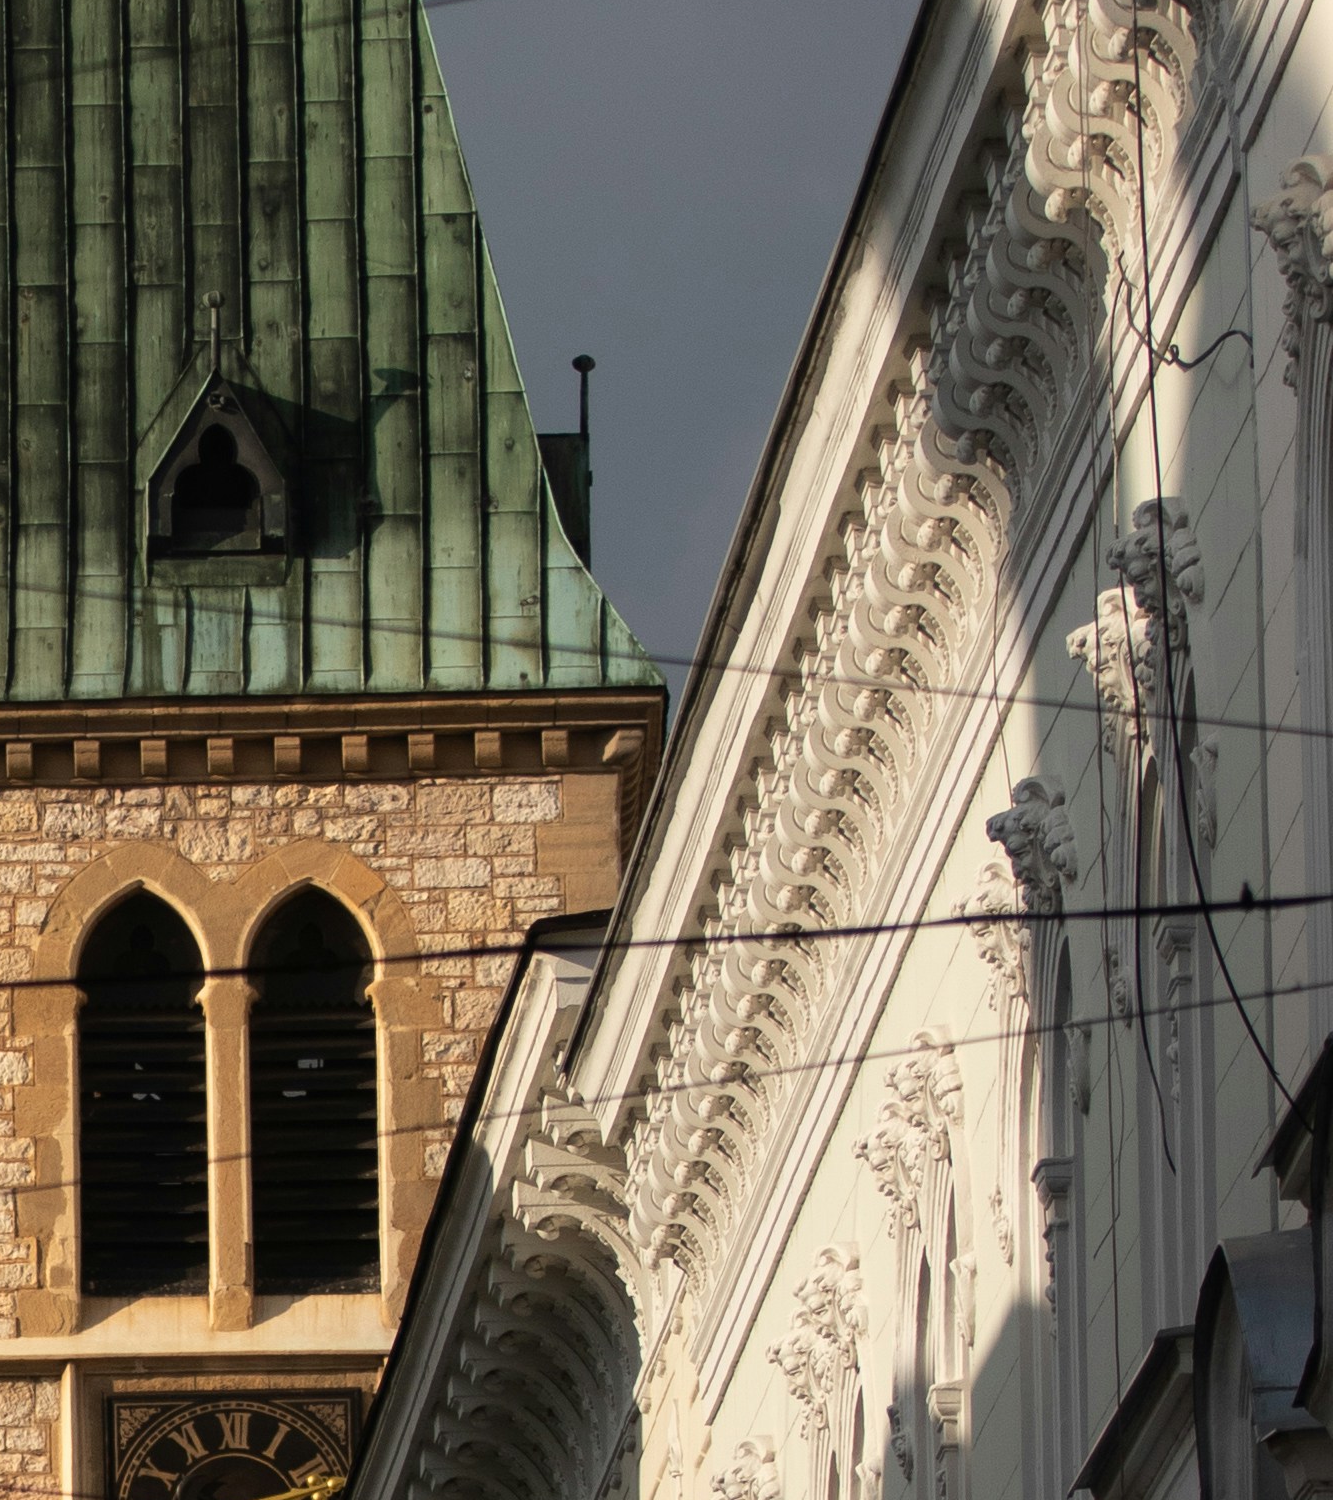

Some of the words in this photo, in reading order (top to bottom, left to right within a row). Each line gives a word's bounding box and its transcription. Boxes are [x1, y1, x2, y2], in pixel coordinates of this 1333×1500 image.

[167, 1421, 210, 1467] XI
[215, 1411, 252, 1450] XII
[262, 1422, 292, 1460] I
[137, 1456, 181, 1492] X
